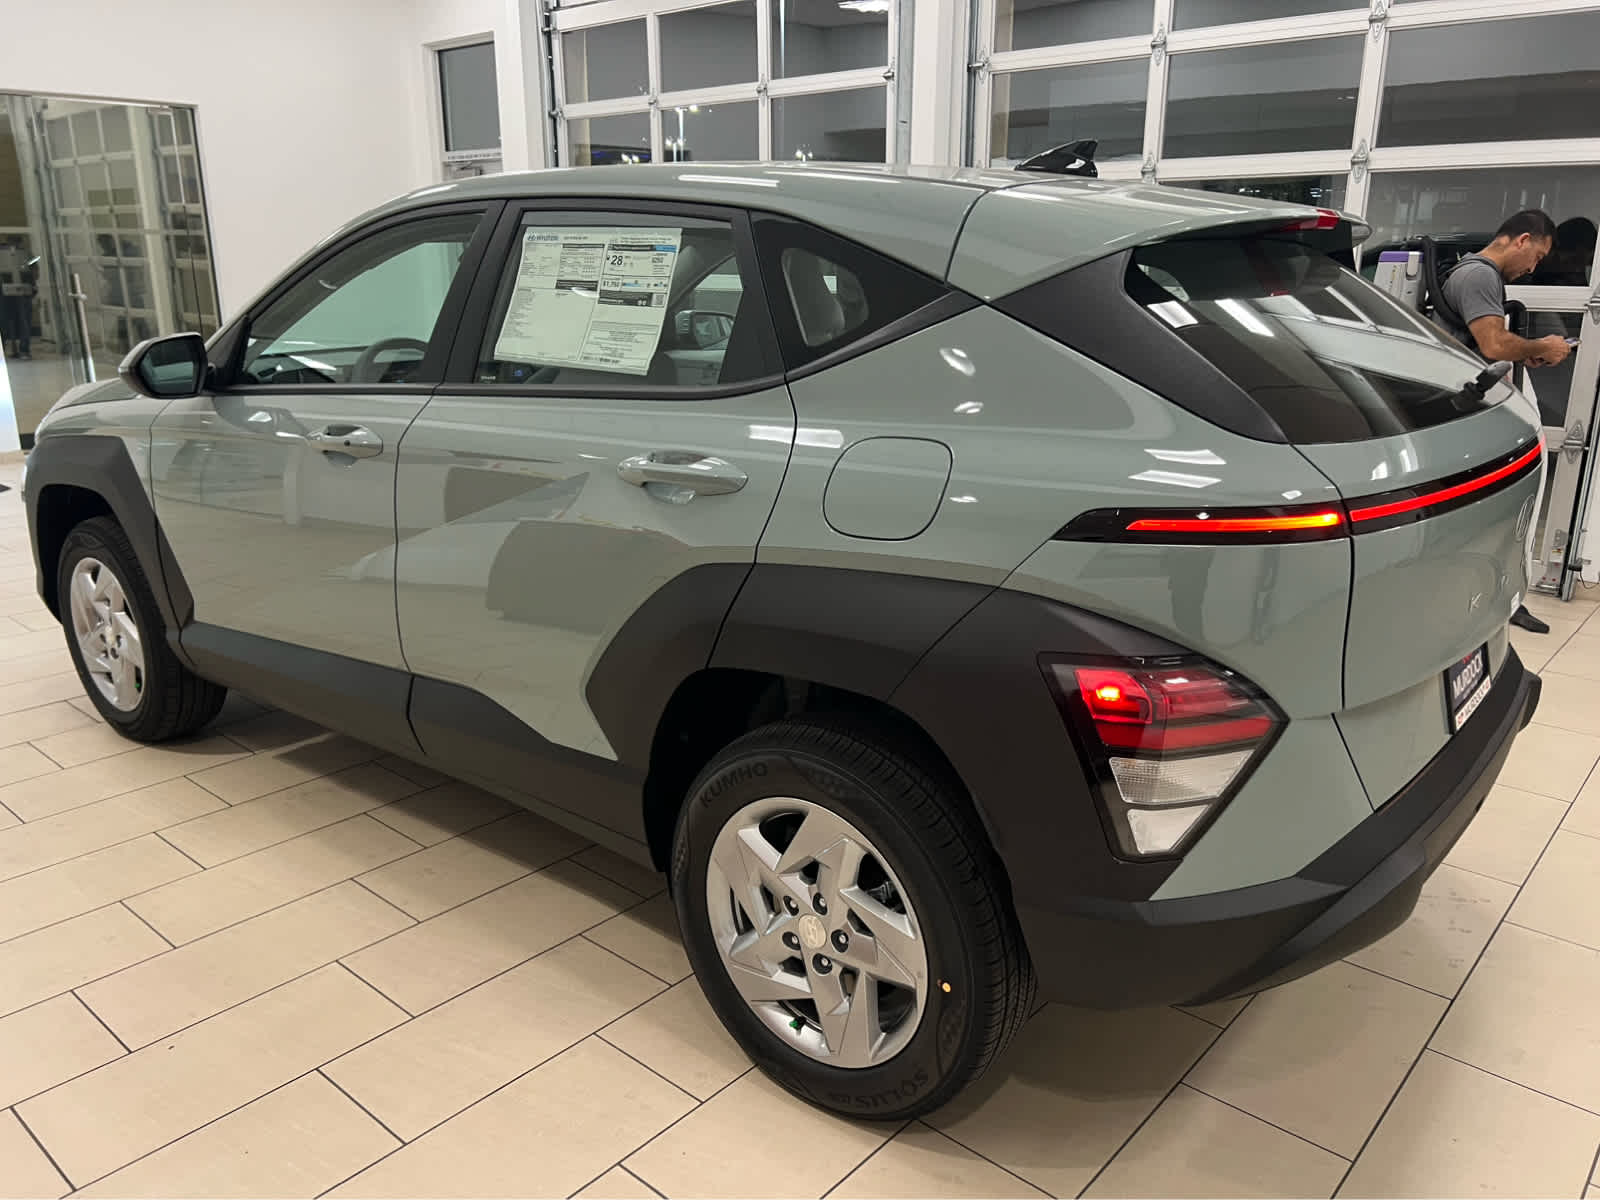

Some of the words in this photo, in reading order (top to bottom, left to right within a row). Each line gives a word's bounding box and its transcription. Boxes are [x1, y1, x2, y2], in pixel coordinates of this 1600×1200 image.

[610, 254, 624, 266] 28
[700, 762, 769, 808] KUMHO
[855, 1067, 929, 1108] SOLUS
